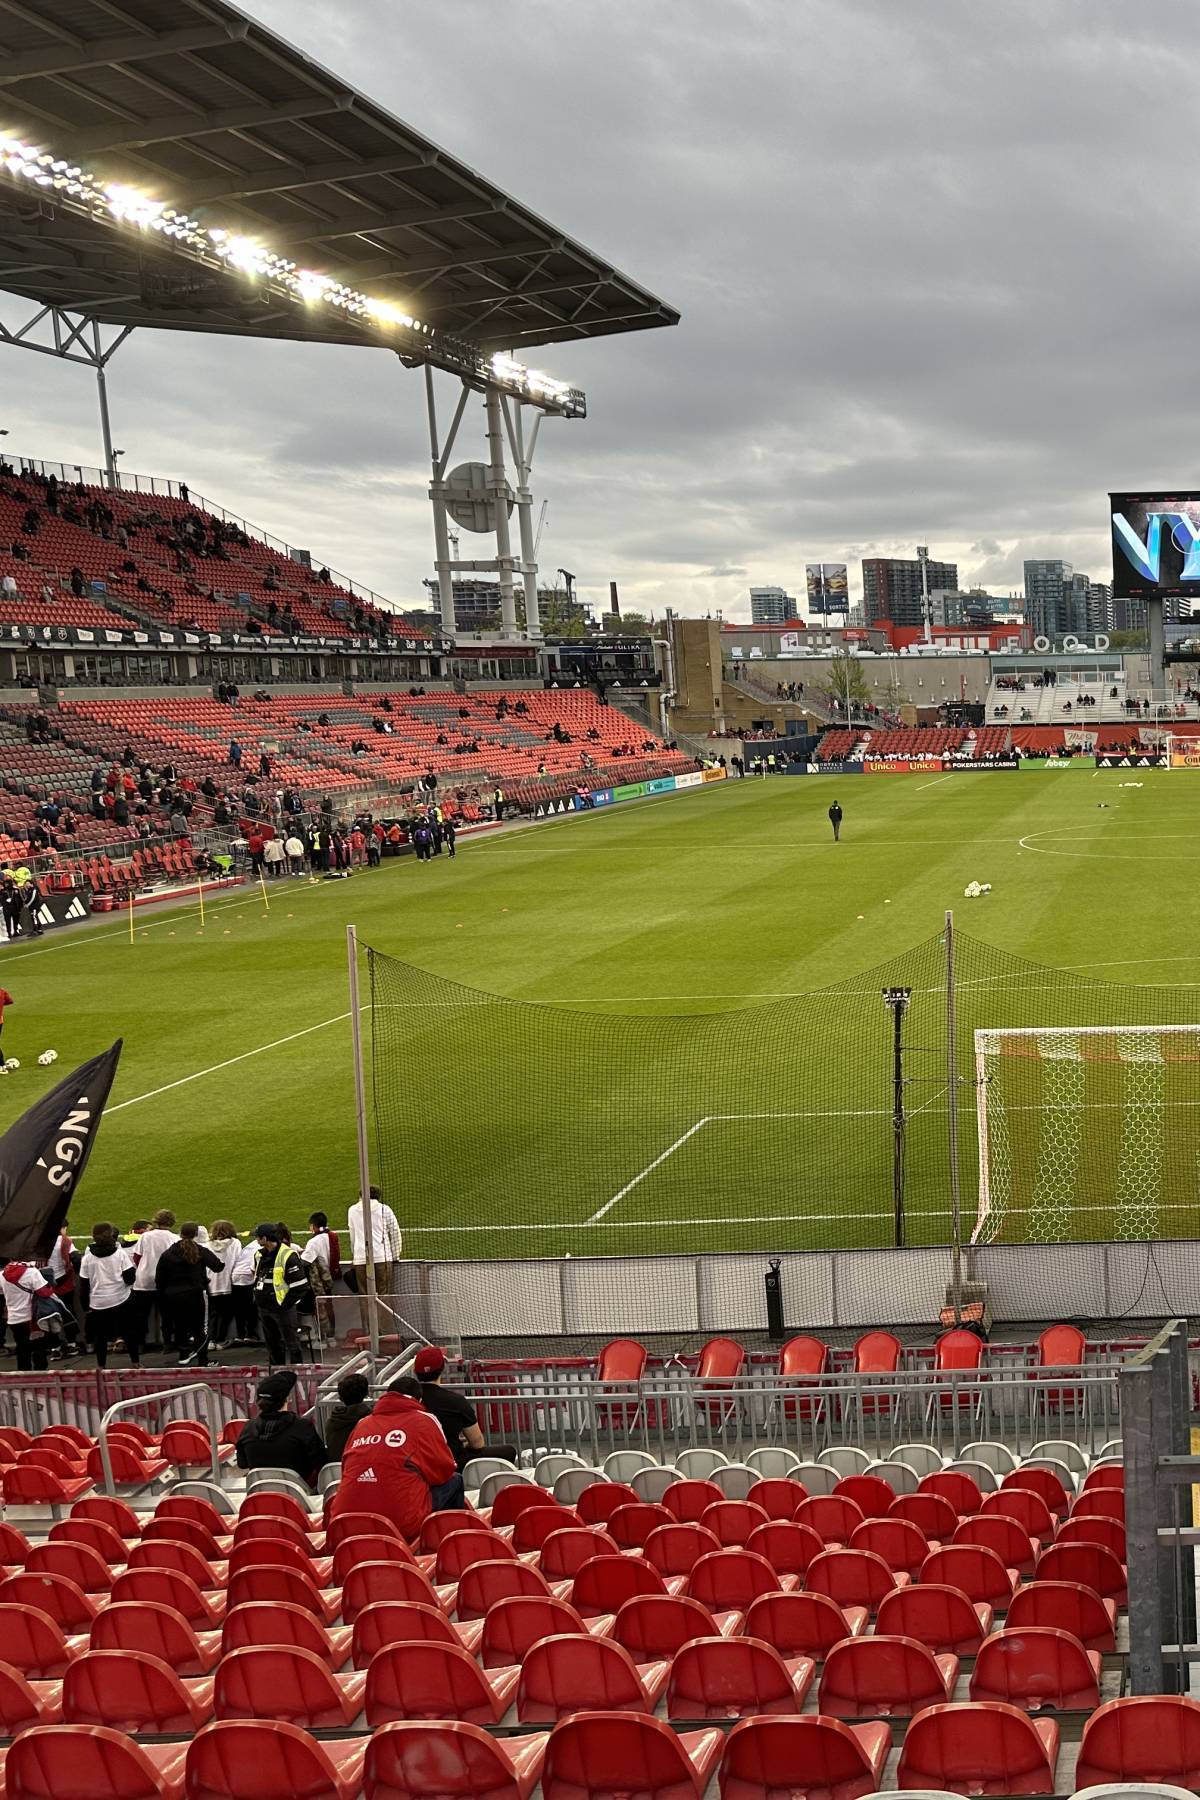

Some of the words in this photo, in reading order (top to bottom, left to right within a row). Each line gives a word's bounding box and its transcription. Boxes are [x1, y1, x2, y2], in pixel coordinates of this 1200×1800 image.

[870, 760, 897, 771] Unico
[909, 760, 936, 770] Unico
[351, 1434, 382, 1449] BMO
